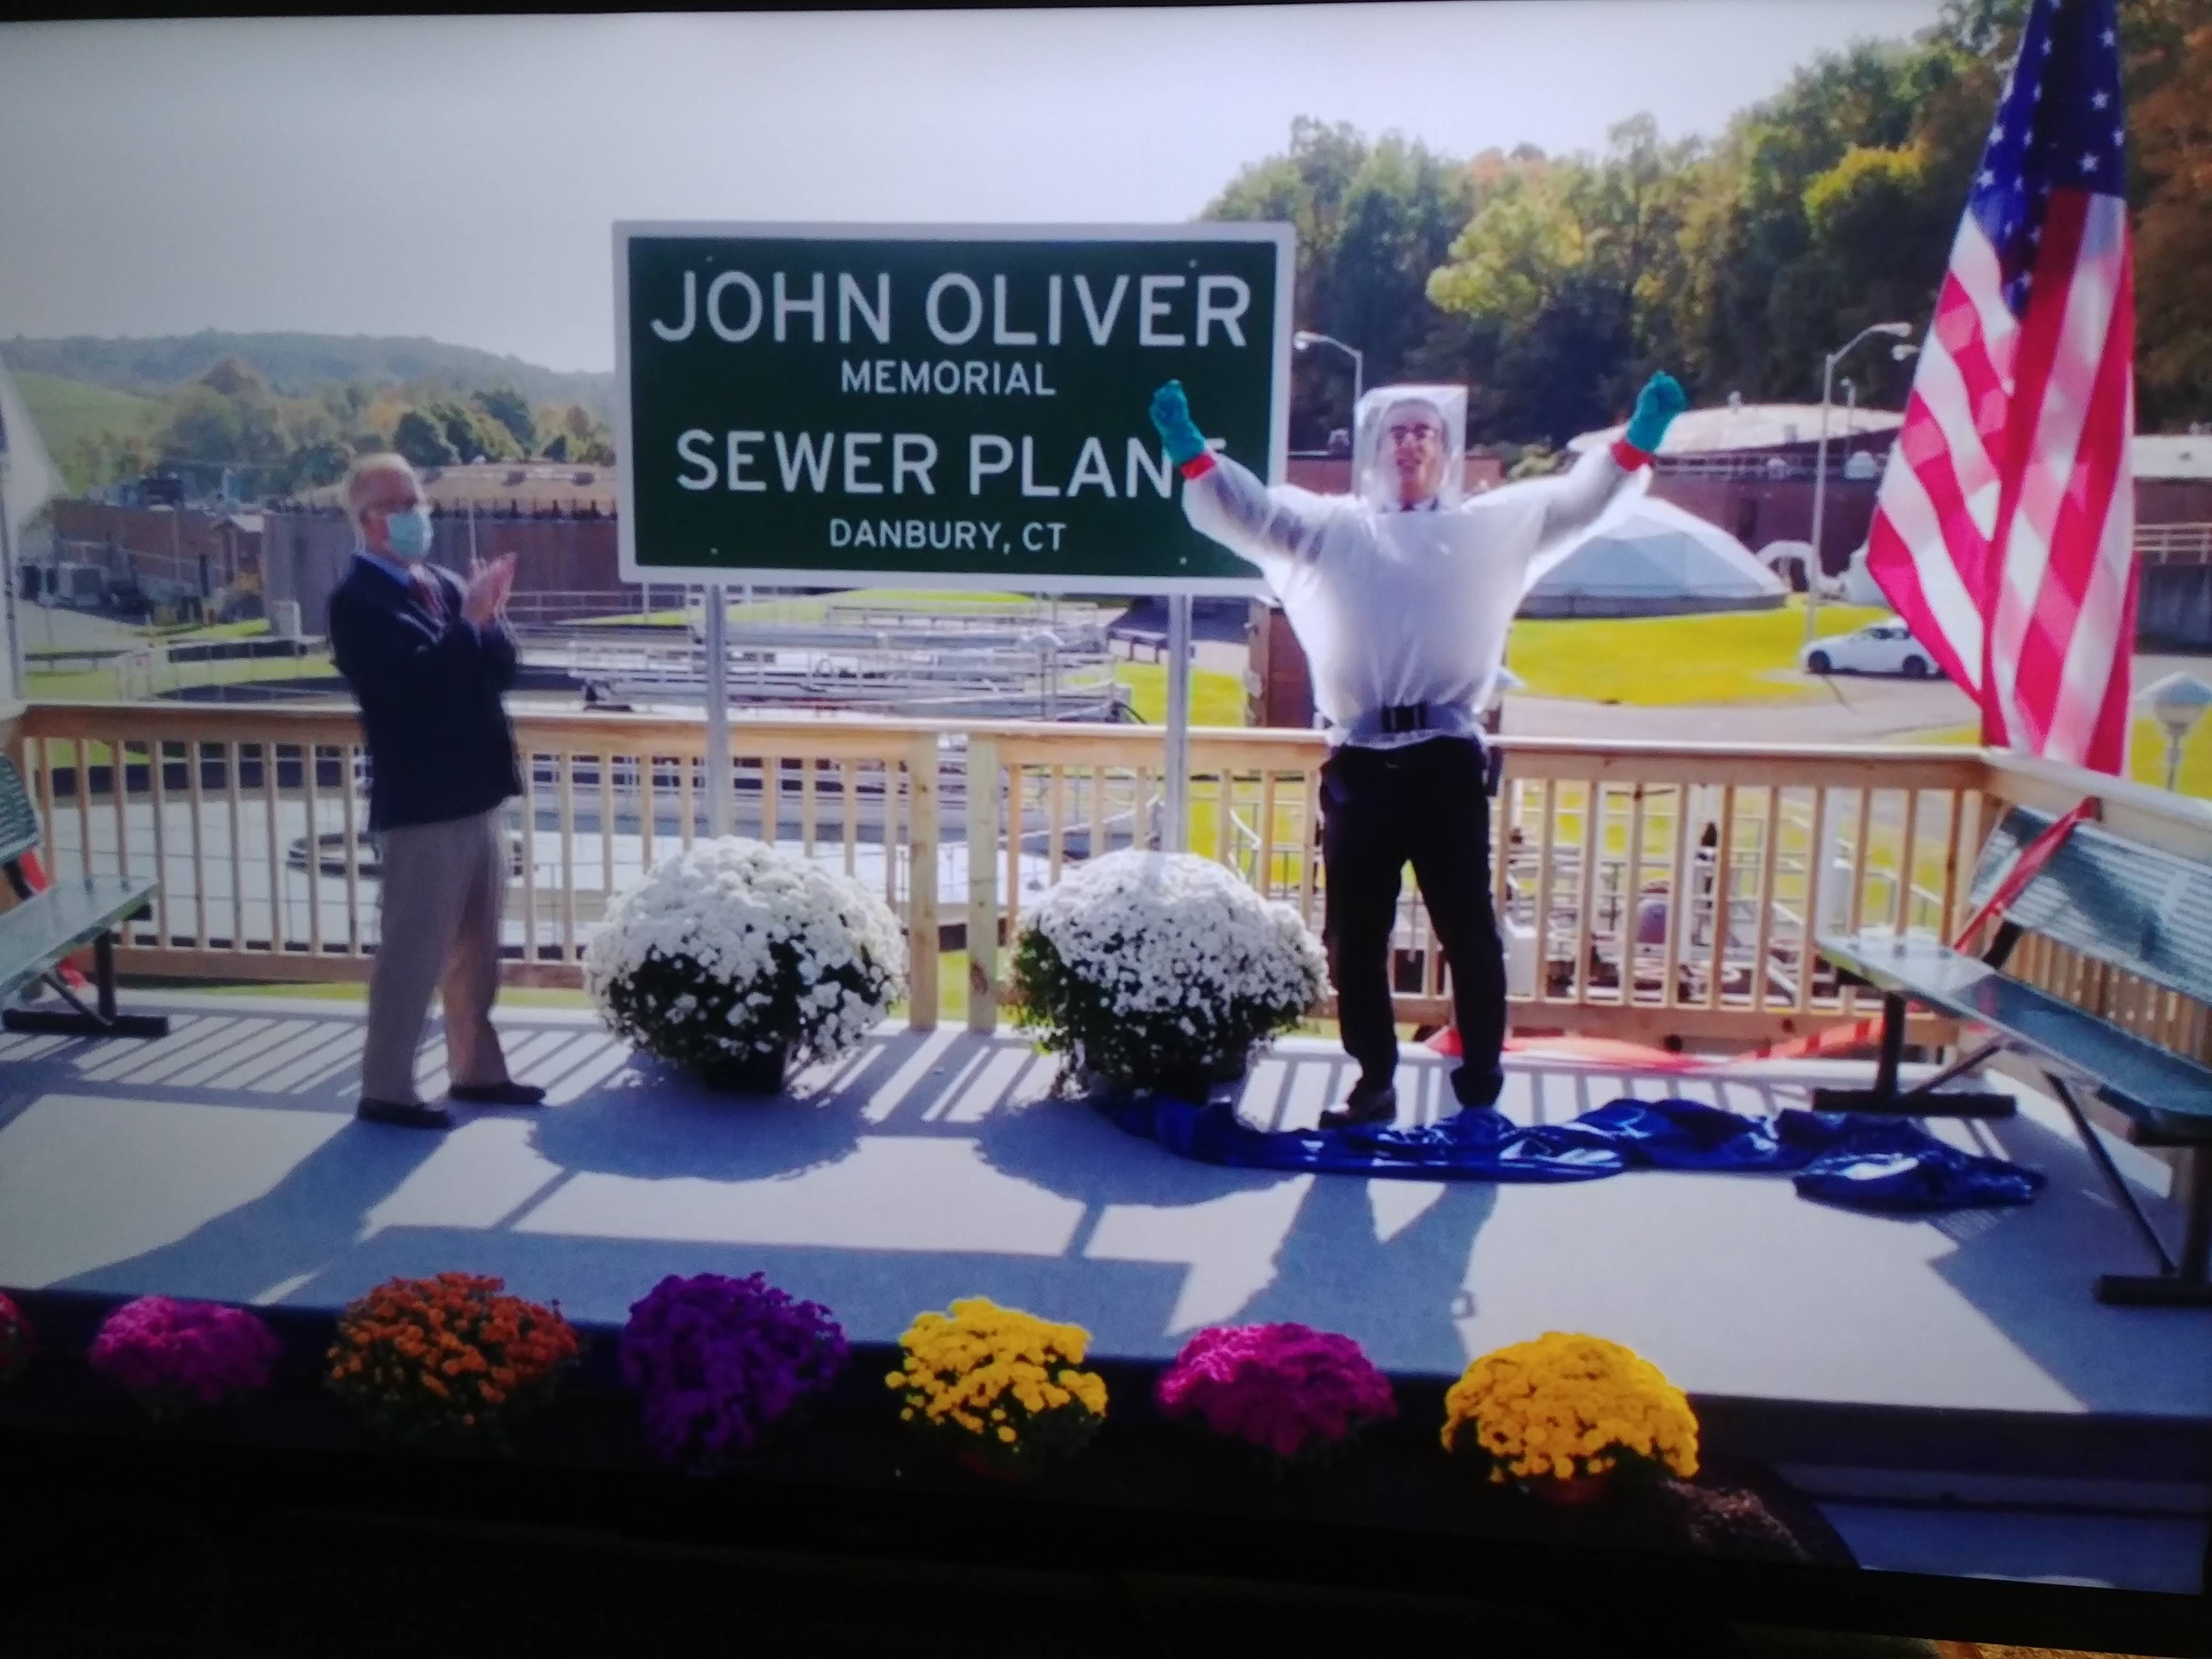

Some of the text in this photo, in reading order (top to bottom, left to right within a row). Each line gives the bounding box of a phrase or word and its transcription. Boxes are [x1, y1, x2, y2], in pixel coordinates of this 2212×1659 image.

[651, 271, 1251, 347] JOHN OLIVER
[841, 359, 1056, 396] MEMORIAL
[677, 429, 1227, 499] SEWER PLAN
[830, 518, 1067, 554] DANBURY, CT
